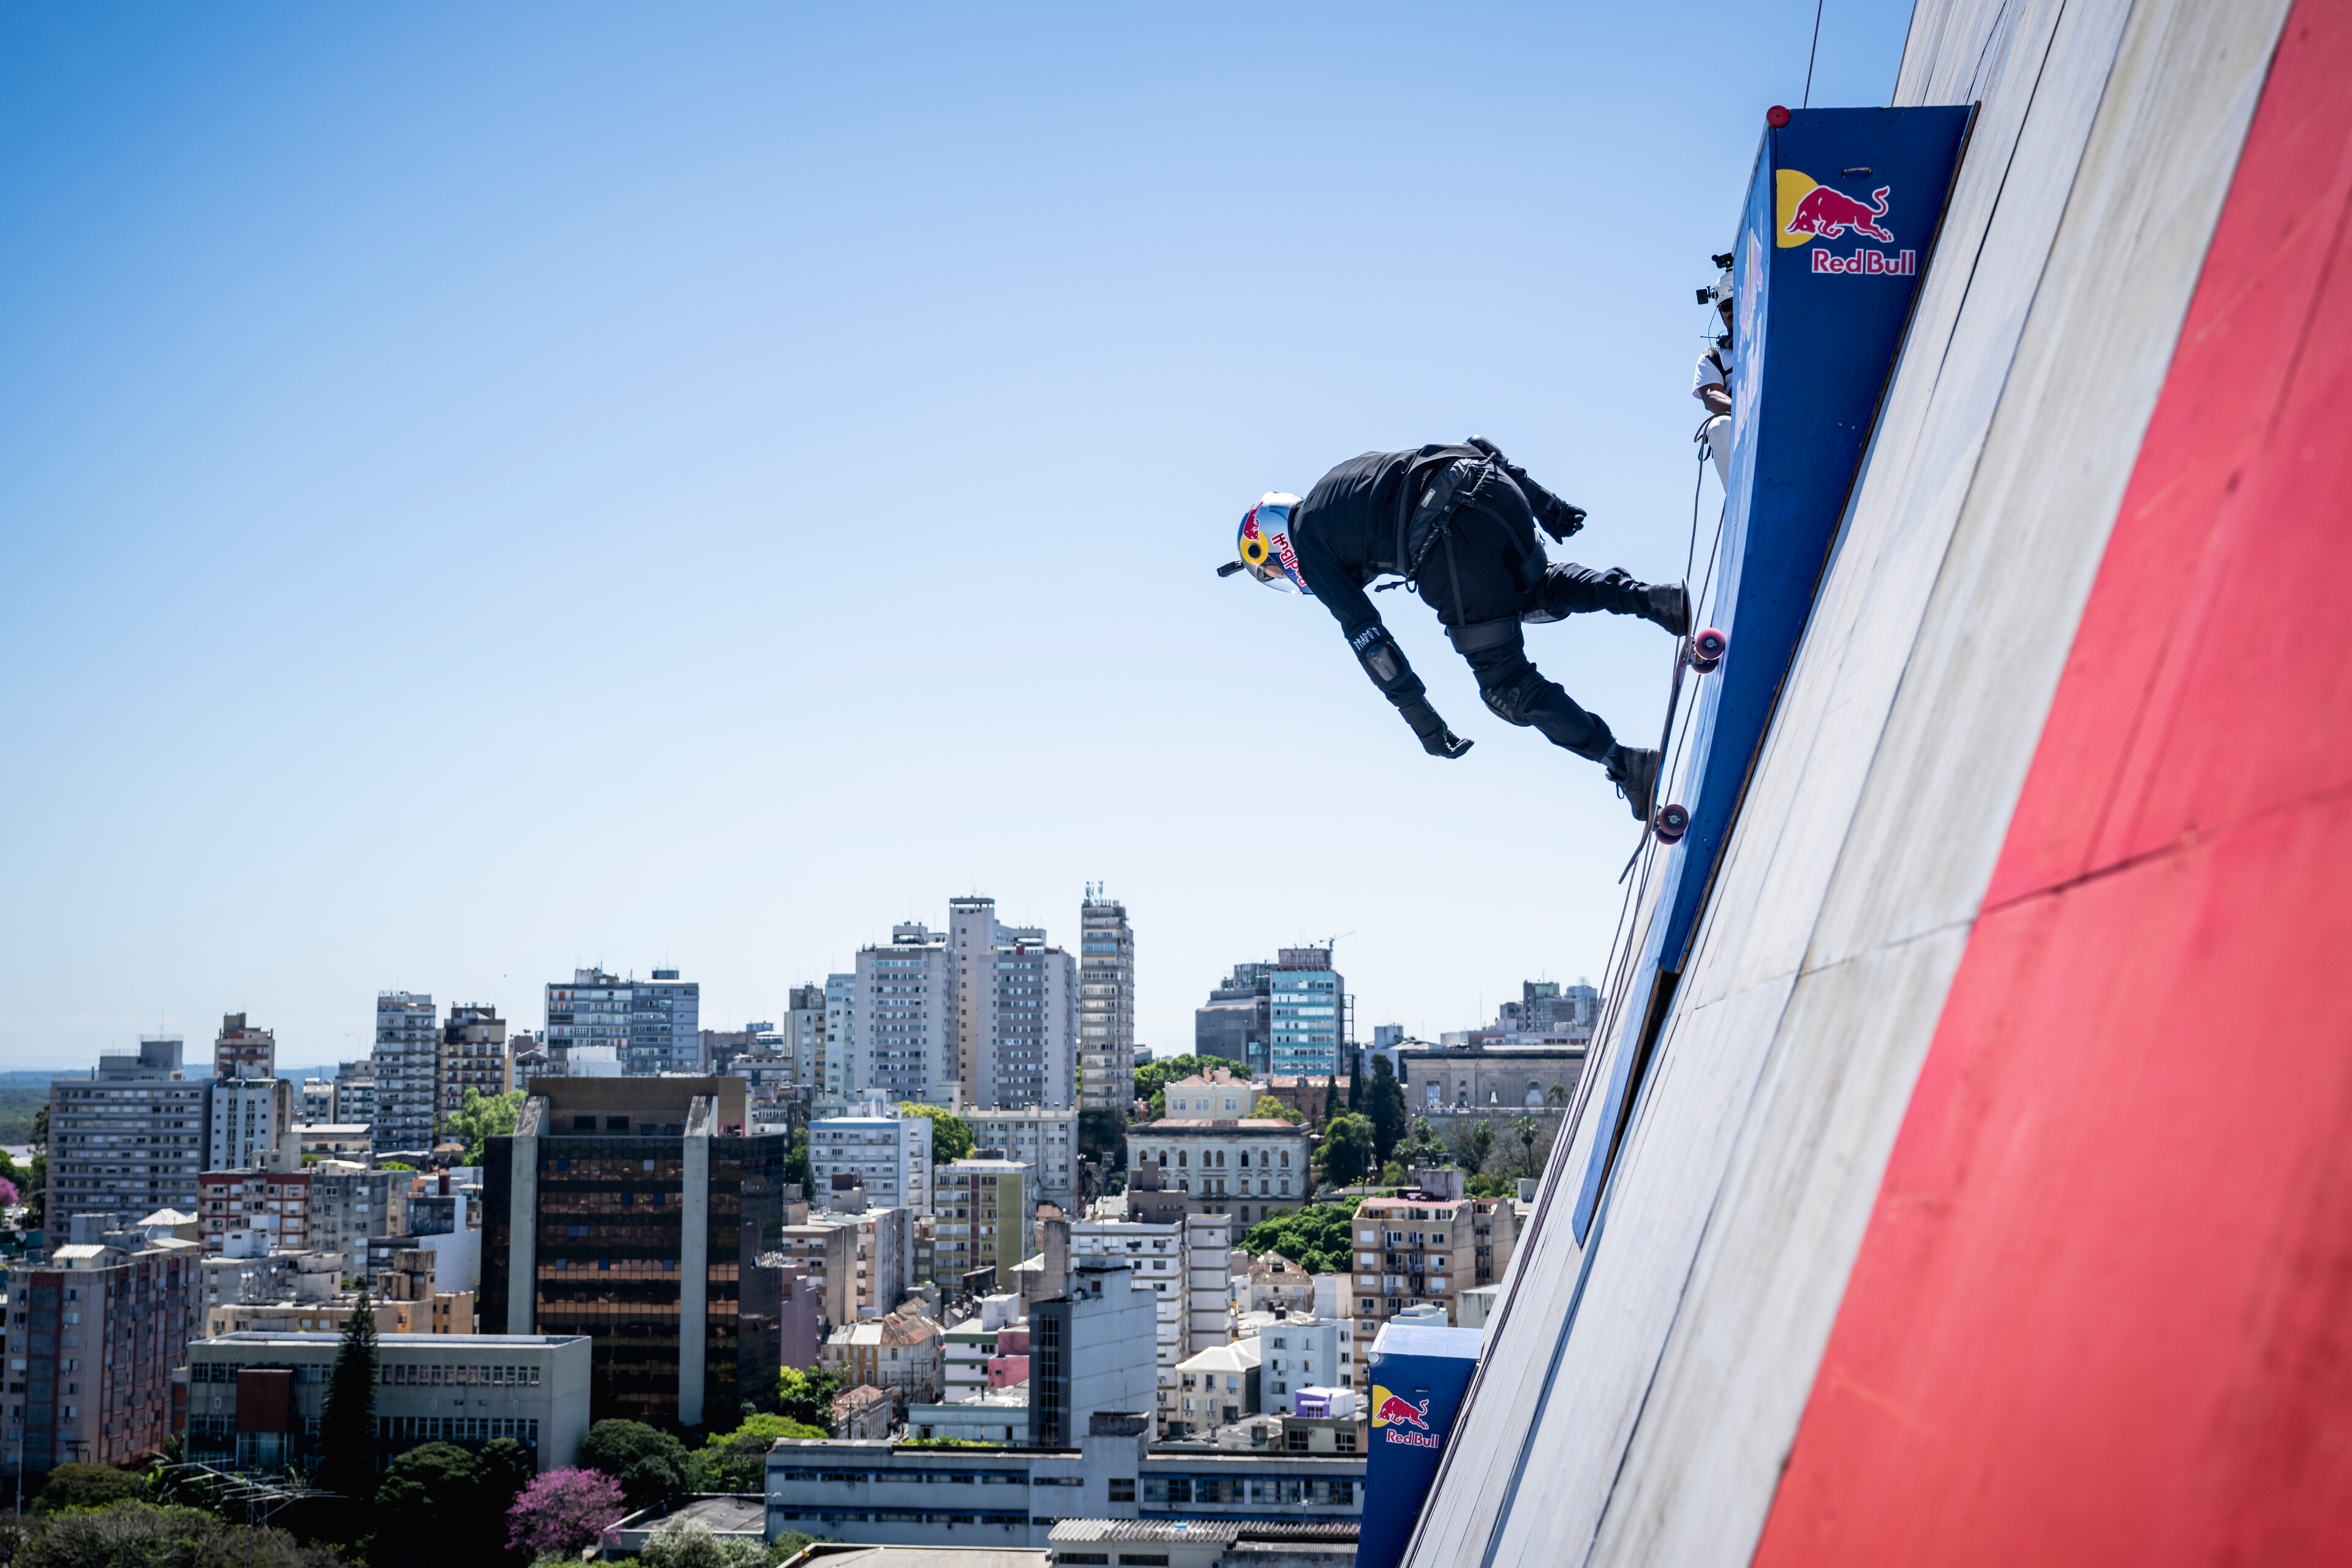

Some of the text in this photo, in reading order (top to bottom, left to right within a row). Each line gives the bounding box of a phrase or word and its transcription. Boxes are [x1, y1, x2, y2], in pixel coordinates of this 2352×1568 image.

[1812, 248, 1916, 276] Red Bull
[1386, 1428, 1439, 1449] Red Bull
